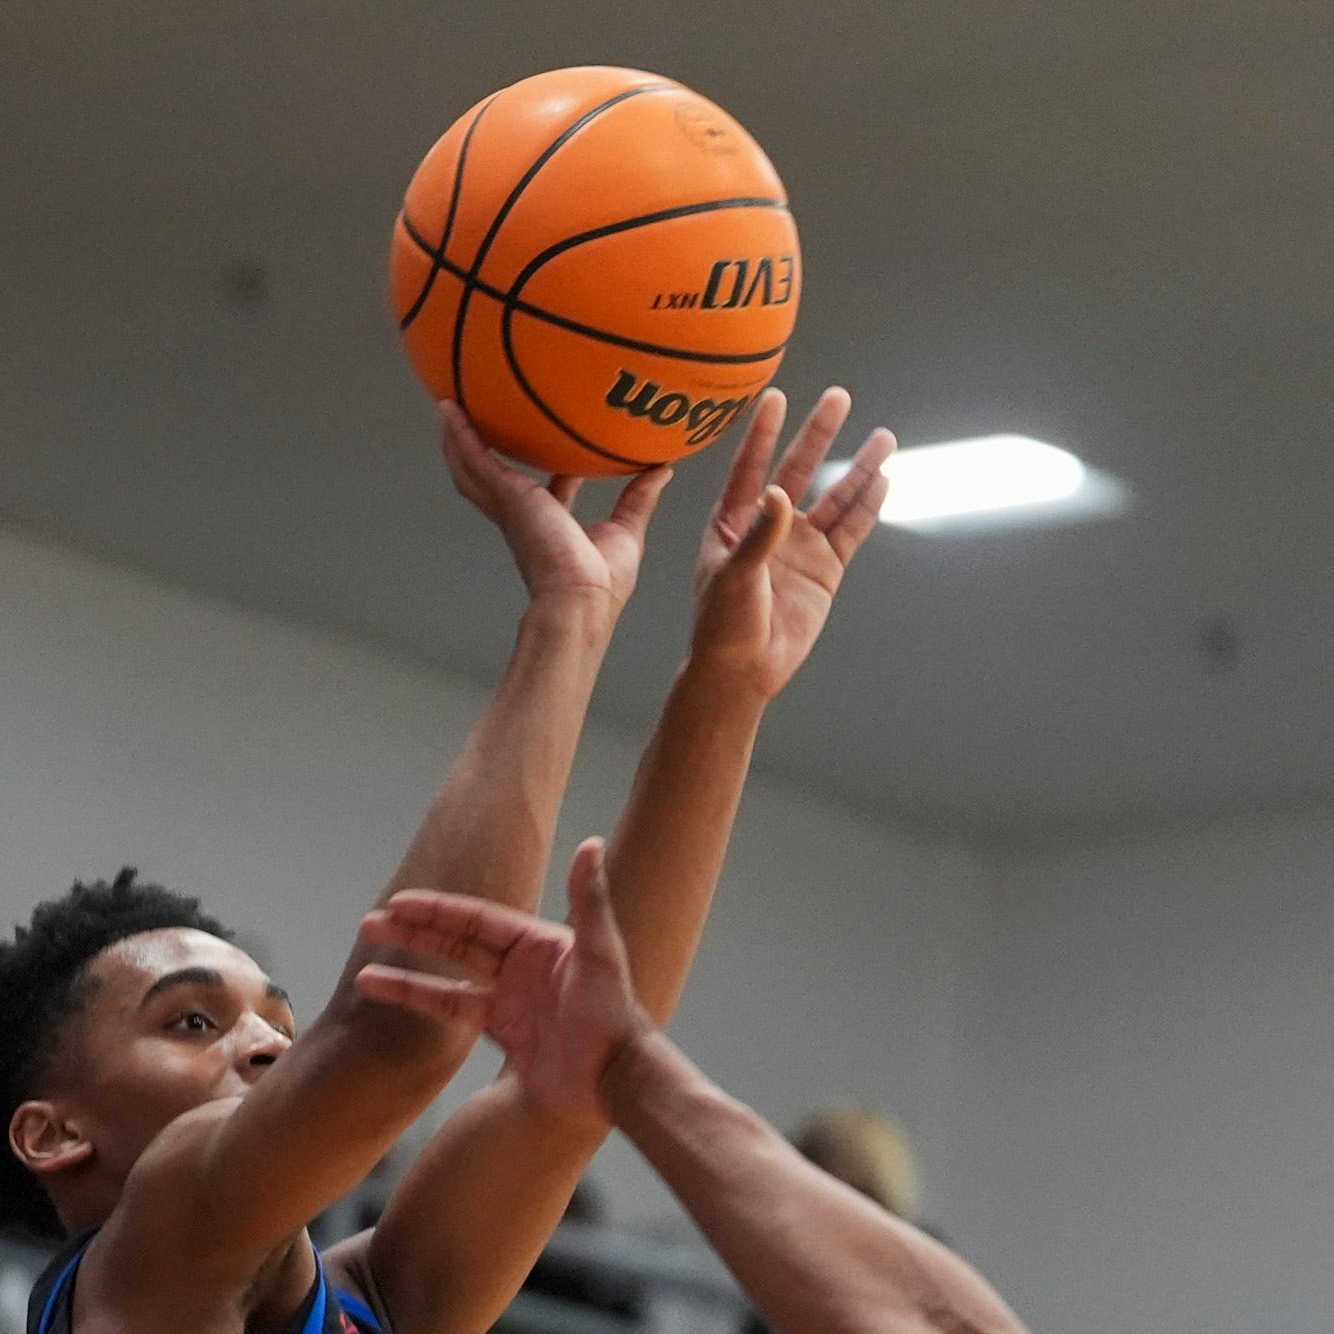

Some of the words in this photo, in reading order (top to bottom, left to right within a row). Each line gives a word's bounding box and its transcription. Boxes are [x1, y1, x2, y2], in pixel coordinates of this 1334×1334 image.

[651, 293, 699, 310] NXT
[700, 257, 793, 309] EVO
[605, 368, 757, 447] lson
